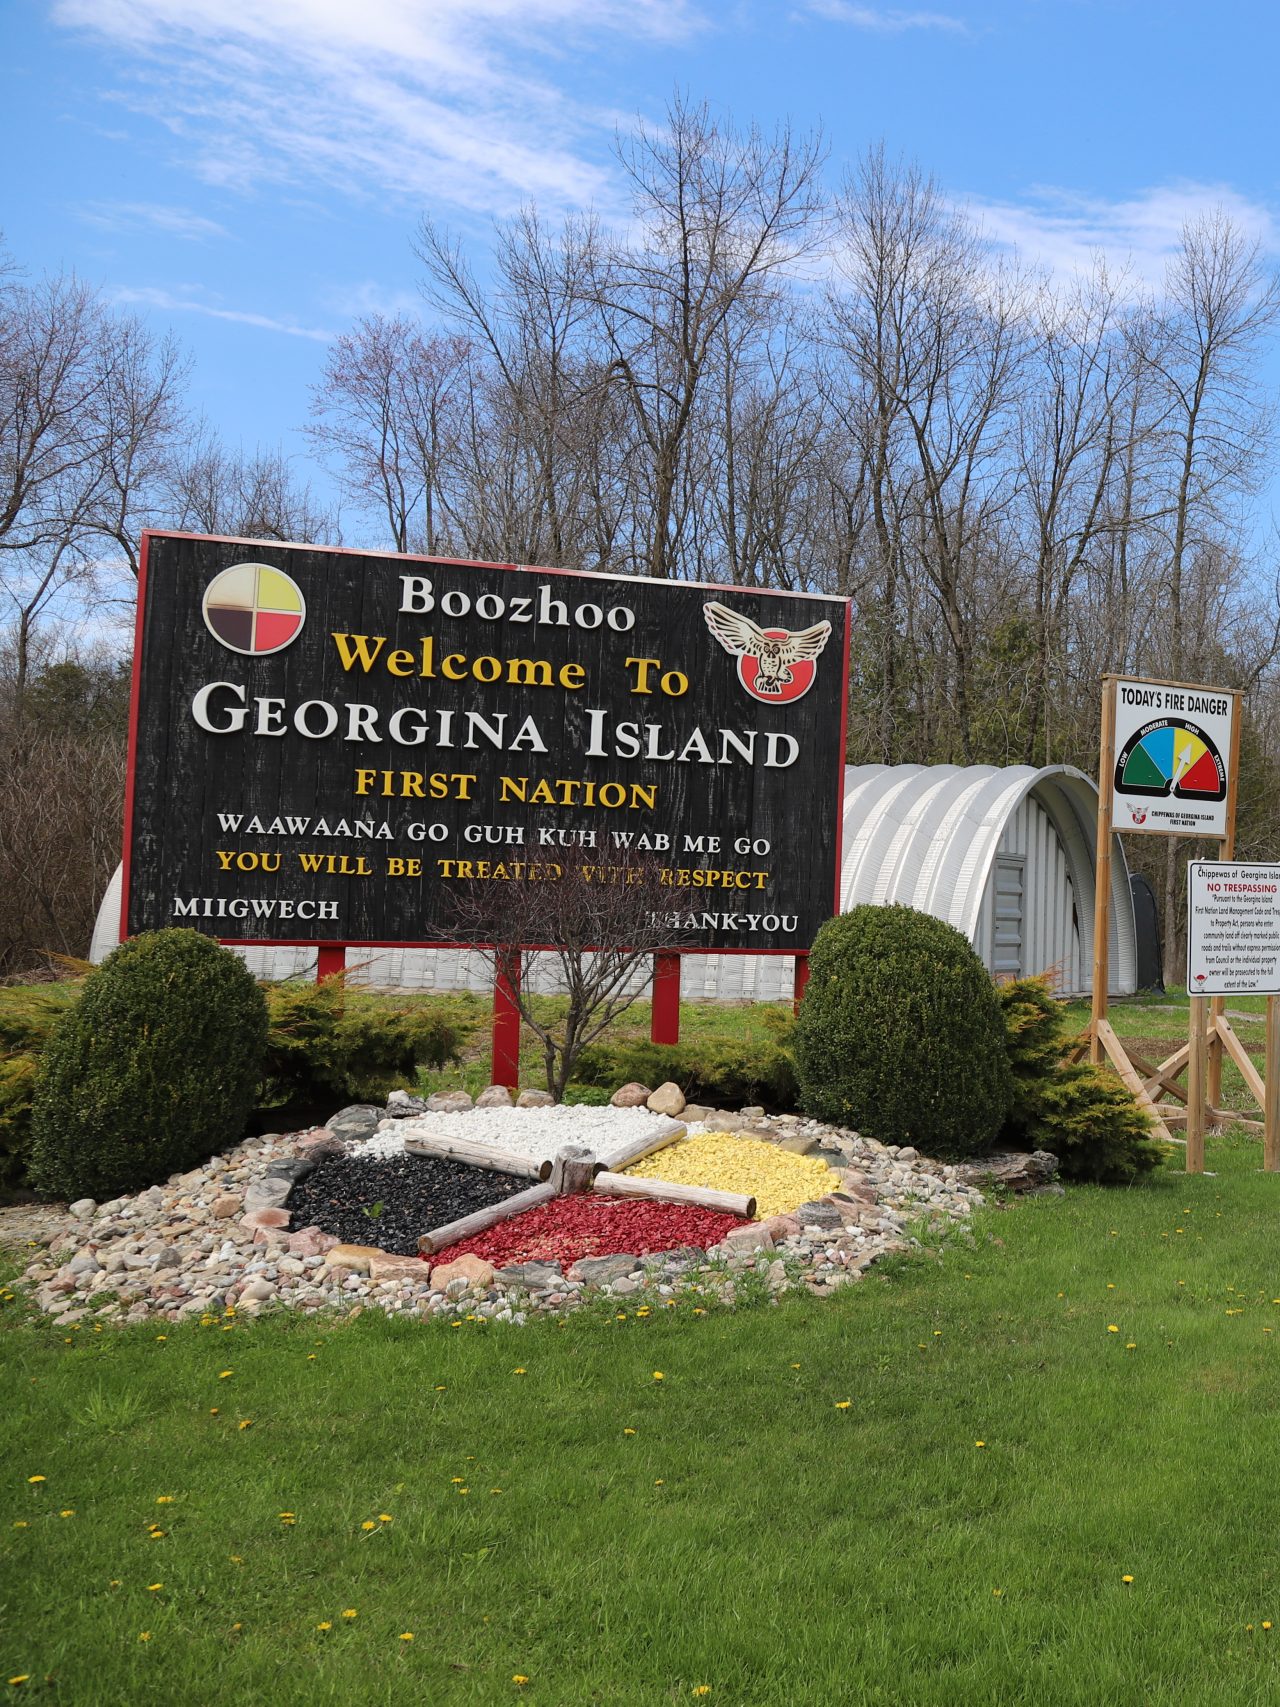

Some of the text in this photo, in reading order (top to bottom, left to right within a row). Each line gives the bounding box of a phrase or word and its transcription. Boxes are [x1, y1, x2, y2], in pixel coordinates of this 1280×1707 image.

[399, 576, 635, 632] Boozhoo
[331, 632, 689, 696] Welcome To
[1121, 688, 1228, 716] TODAY'S FIRE DANGER
[192, 682, 799, 767] GEORGINA ISLAND
[1140, 720, 1168, 736] MODERATE
[1184, 723, 1200, 735] HIGH
[1118, 752, 1128, 768] LOW
[1214, 754, 1225, 782] EXTREME
[355, 769, 658, 809] FIRST NATION
[217, 813, 771, 856] WAAWAANA GO GUH KUH WAB ME GO
[216, 851, 282, 872] YOU
[298, 854, 373, 876] WILL
[387, 858, 423, 877] BE
[438, 860, 562, 881] TREATED
[659, 869, 769, 889] RESPECT
[1198, 868, 1230, 880] Chippewas
[1241, 870, 1267, 880] Georgina
[1207, 883, 1277, 893] NO TRESPASSING
[173, 898, 339, 920] MIIGWECH
